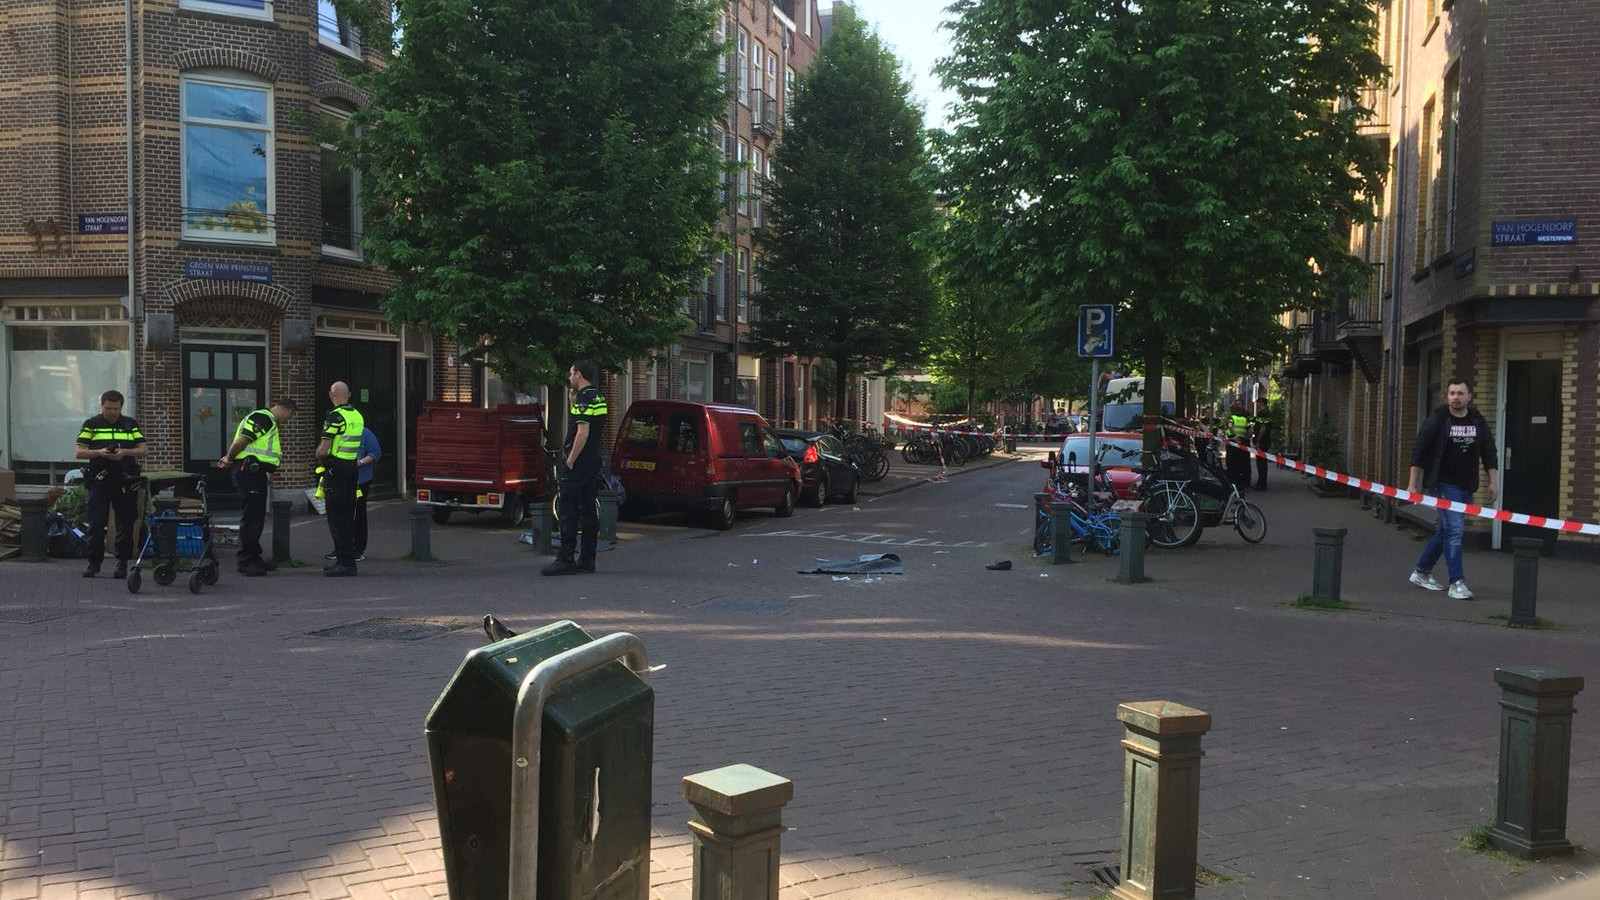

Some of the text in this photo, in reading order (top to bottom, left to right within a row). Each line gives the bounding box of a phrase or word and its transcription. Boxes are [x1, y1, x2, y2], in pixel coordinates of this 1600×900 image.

[96, 216, 127, 224] HOGENDORP
[1495, 222, 1574, 233] VAN HOGENDORP
[1495, 234, 1526, 243] STRAAT
[189, 261, 213, 270] GROEN
[215, 263, 229, 271] VAN
[189, 269, 213, 278] STRAAT
[1086, 309, 1106, 334] P
